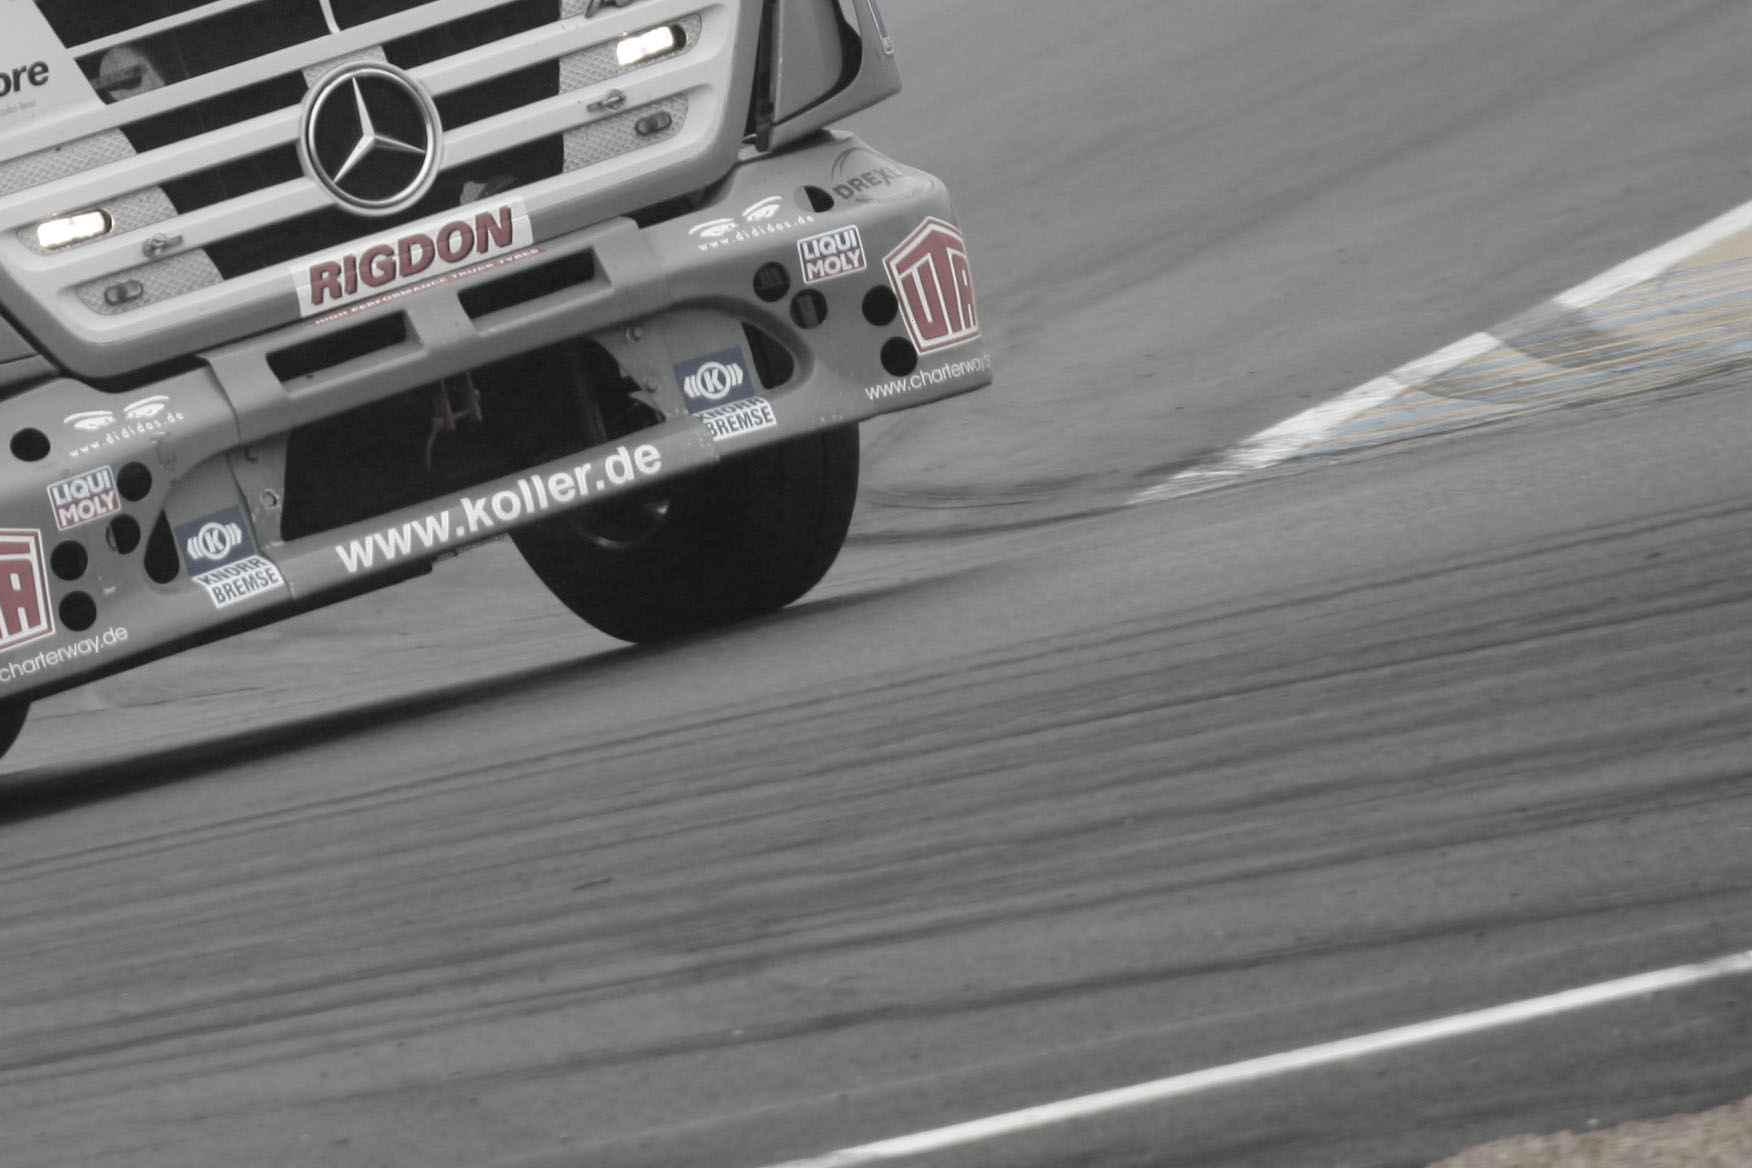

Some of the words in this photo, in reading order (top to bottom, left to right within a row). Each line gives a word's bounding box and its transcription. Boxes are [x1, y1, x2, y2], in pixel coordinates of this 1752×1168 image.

[309, 205, 514, 306] RIGDON
[801, 229, 859, 260] LIQUI
[805, 250, 863, 281] MOLY
[706, 404, 774, 438] BREMSE
[52, 469, 112, 507] LIQUI
[58, 490, 115, 528] MOLY
[334, 443, 663, 575] www.koller.de
[197, 557, 269, 586] KNORR
[211, 567, 280, 604] BREMSE
